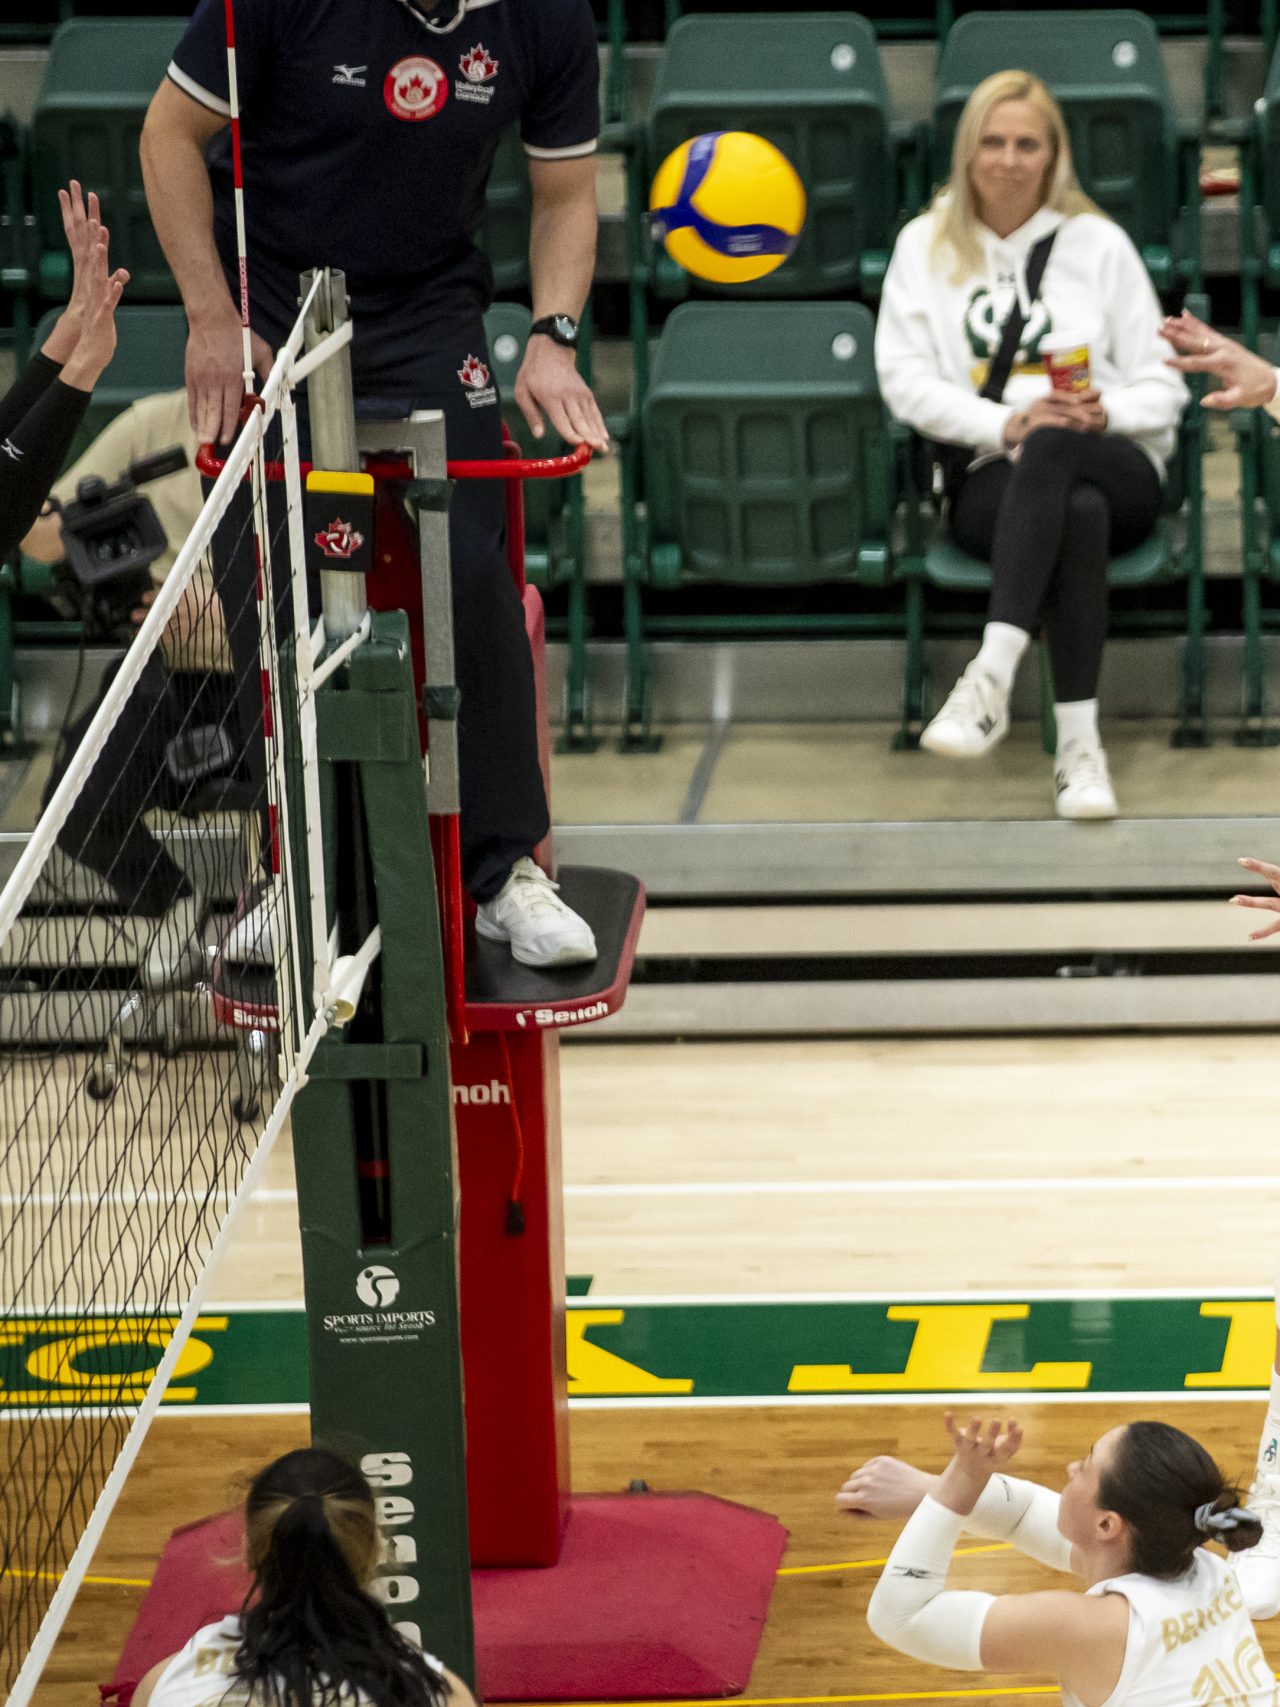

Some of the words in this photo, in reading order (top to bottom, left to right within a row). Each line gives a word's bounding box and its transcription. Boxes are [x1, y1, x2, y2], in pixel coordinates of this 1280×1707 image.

[534, 1001, 609, 1026] Senoh
[450, 1079, 511, 1105] noh
[323, 1315, 374, 1331] SPORTS
[375, 1310, 436, 1326] IMPORTS
